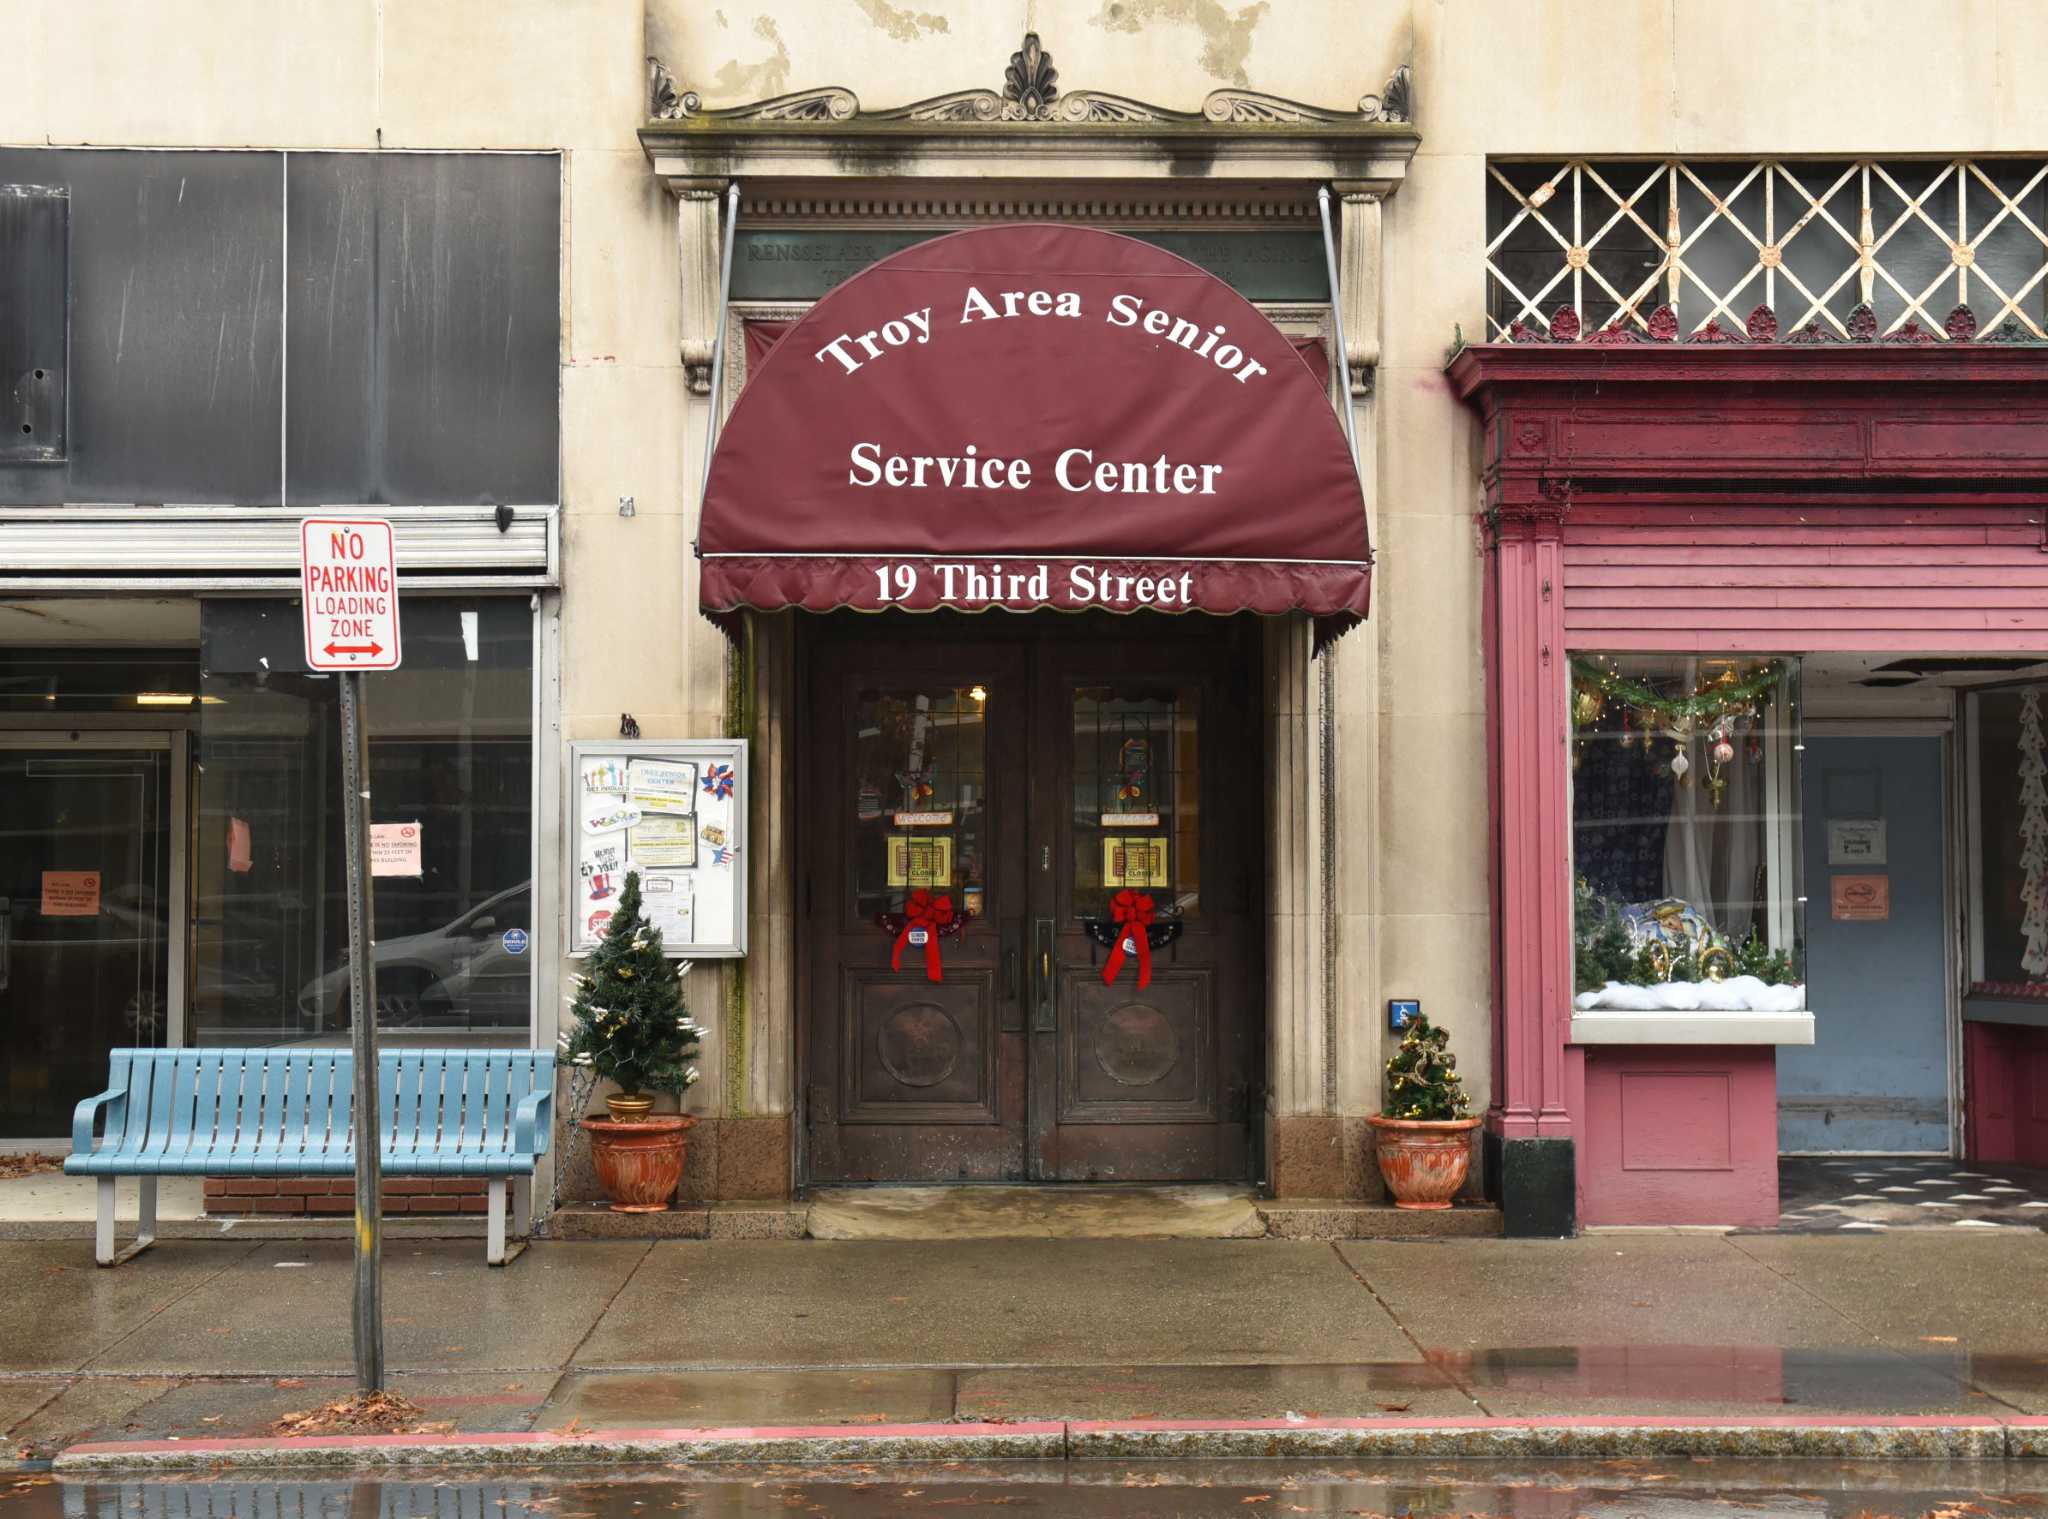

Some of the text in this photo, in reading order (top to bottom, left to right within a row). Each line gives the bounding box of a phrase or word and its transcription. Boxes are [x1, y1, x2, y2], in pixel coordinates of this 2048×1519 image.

[747, 243, 878, 262] RENSSELAER
[814, 286, 1268, 384] Troy Area Senior
[849, 442, 1223, 495] Service Center
[330, 532, 365, 561] NO
[309, 564, 389, 594] PARKING
[874, 564, 1193, 604] 19 Third Street
[315, 596, 387, 616] LOADING
[330, 618, 374, 638] ZONE
